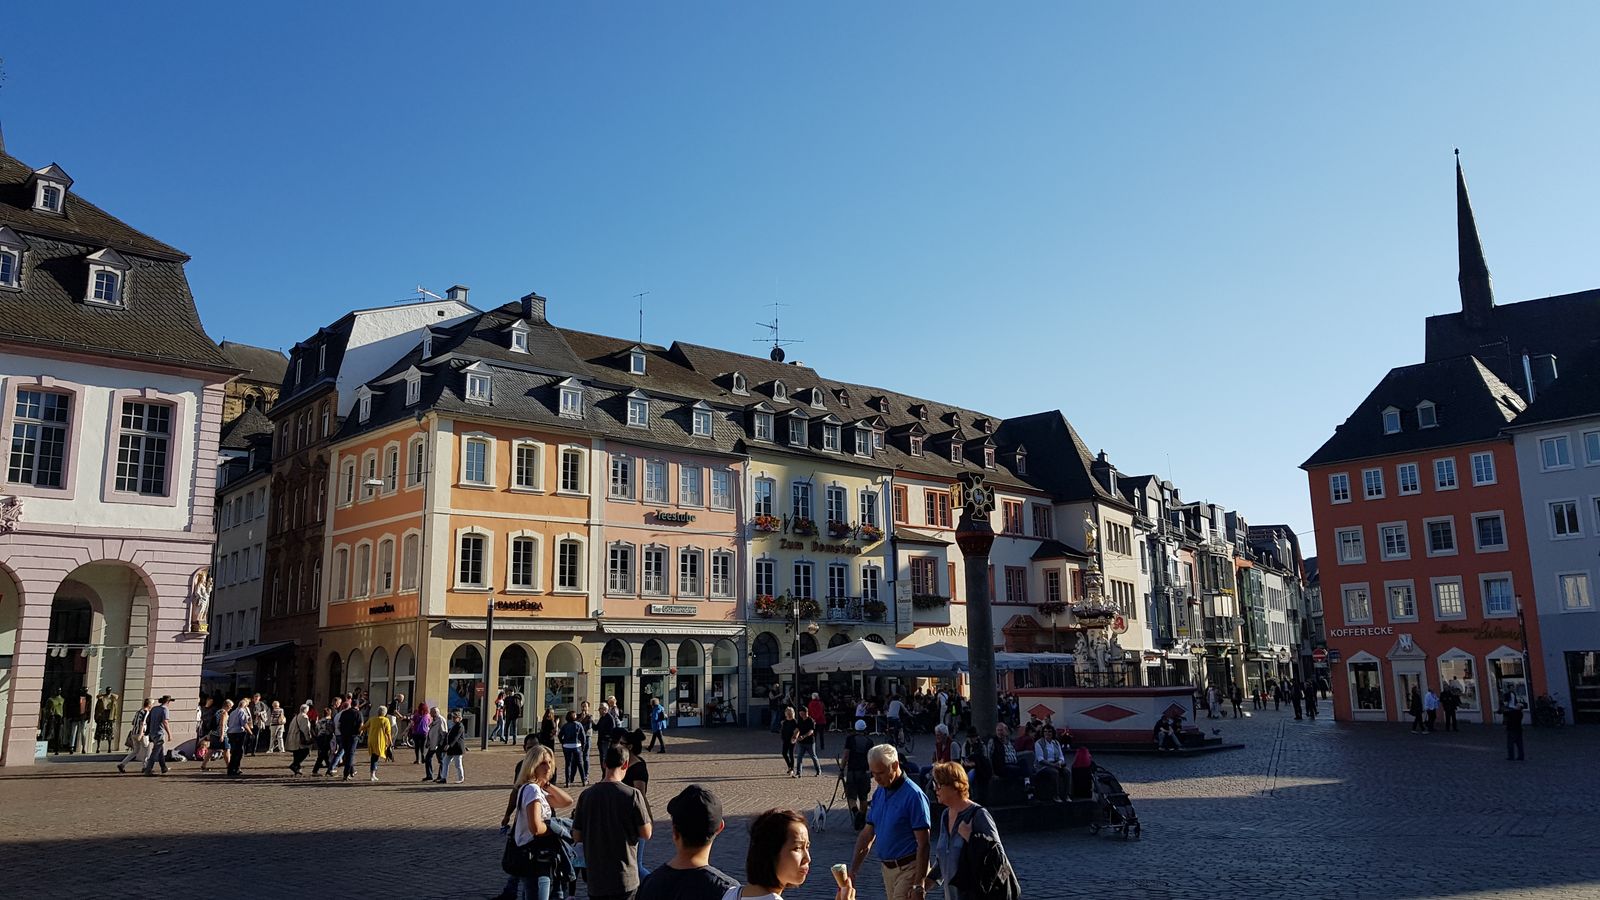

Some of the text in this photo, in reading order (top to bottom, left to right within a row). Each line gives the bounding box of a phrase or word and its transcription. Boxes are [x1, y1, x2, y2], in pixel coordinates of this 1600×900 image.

[656, 509, 697, 522] Teestube
[779, 538, 862, 554] Zum Domstein
[1175, 590, 1186, 627] OPTIK
[1330, 626, 1394, 637] KOFFER ECKE
